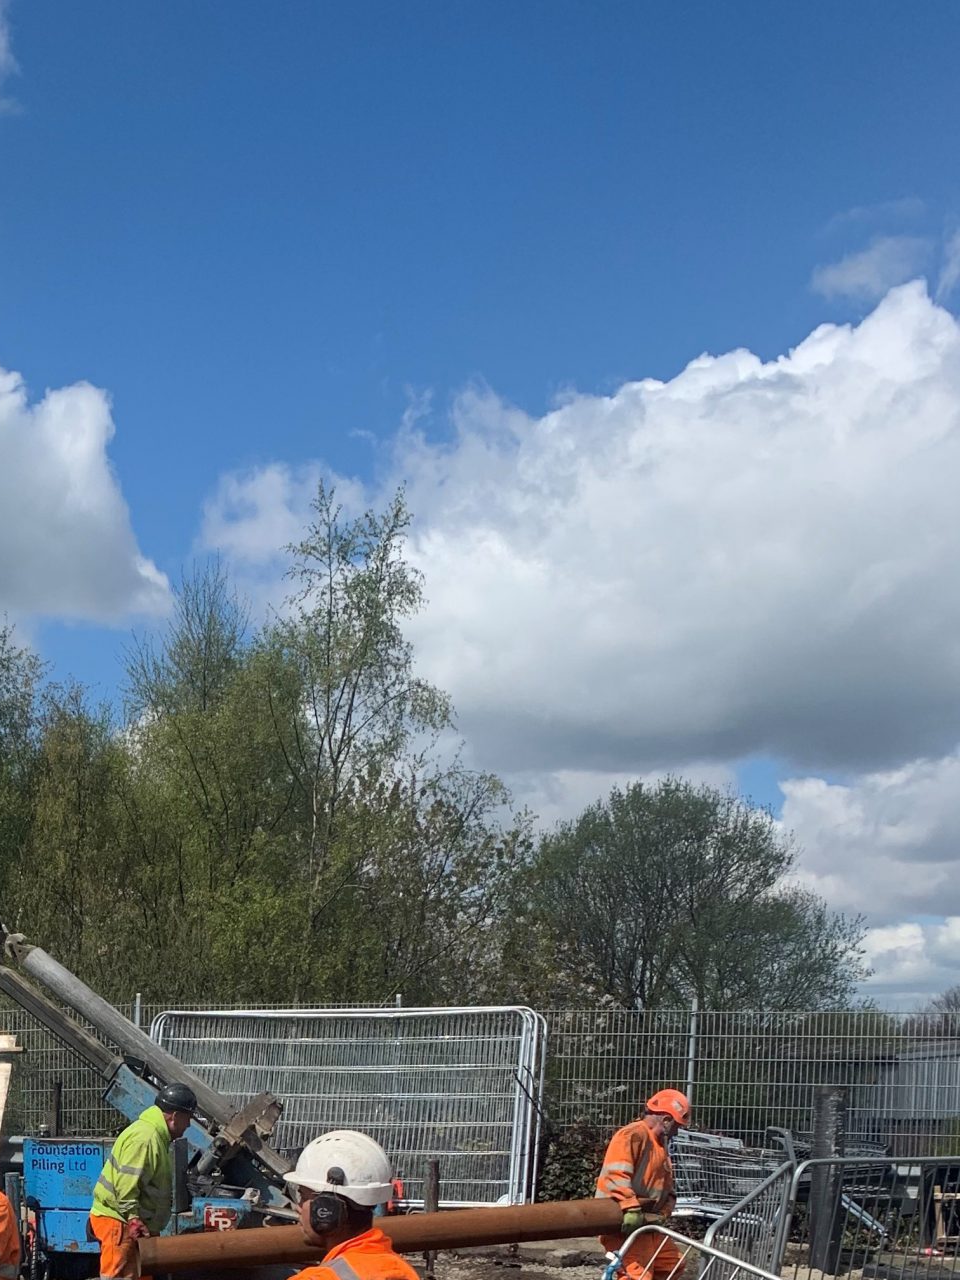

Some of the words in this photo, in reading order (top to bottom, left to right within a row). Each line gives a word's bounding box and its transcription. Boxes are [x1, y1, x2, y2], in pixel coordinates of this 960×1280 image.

[31, 1144, 101, 1156] Foundation
[31, 1159, 65, 1174] Piling
[68, 1159, 87, 1171] Ltd
